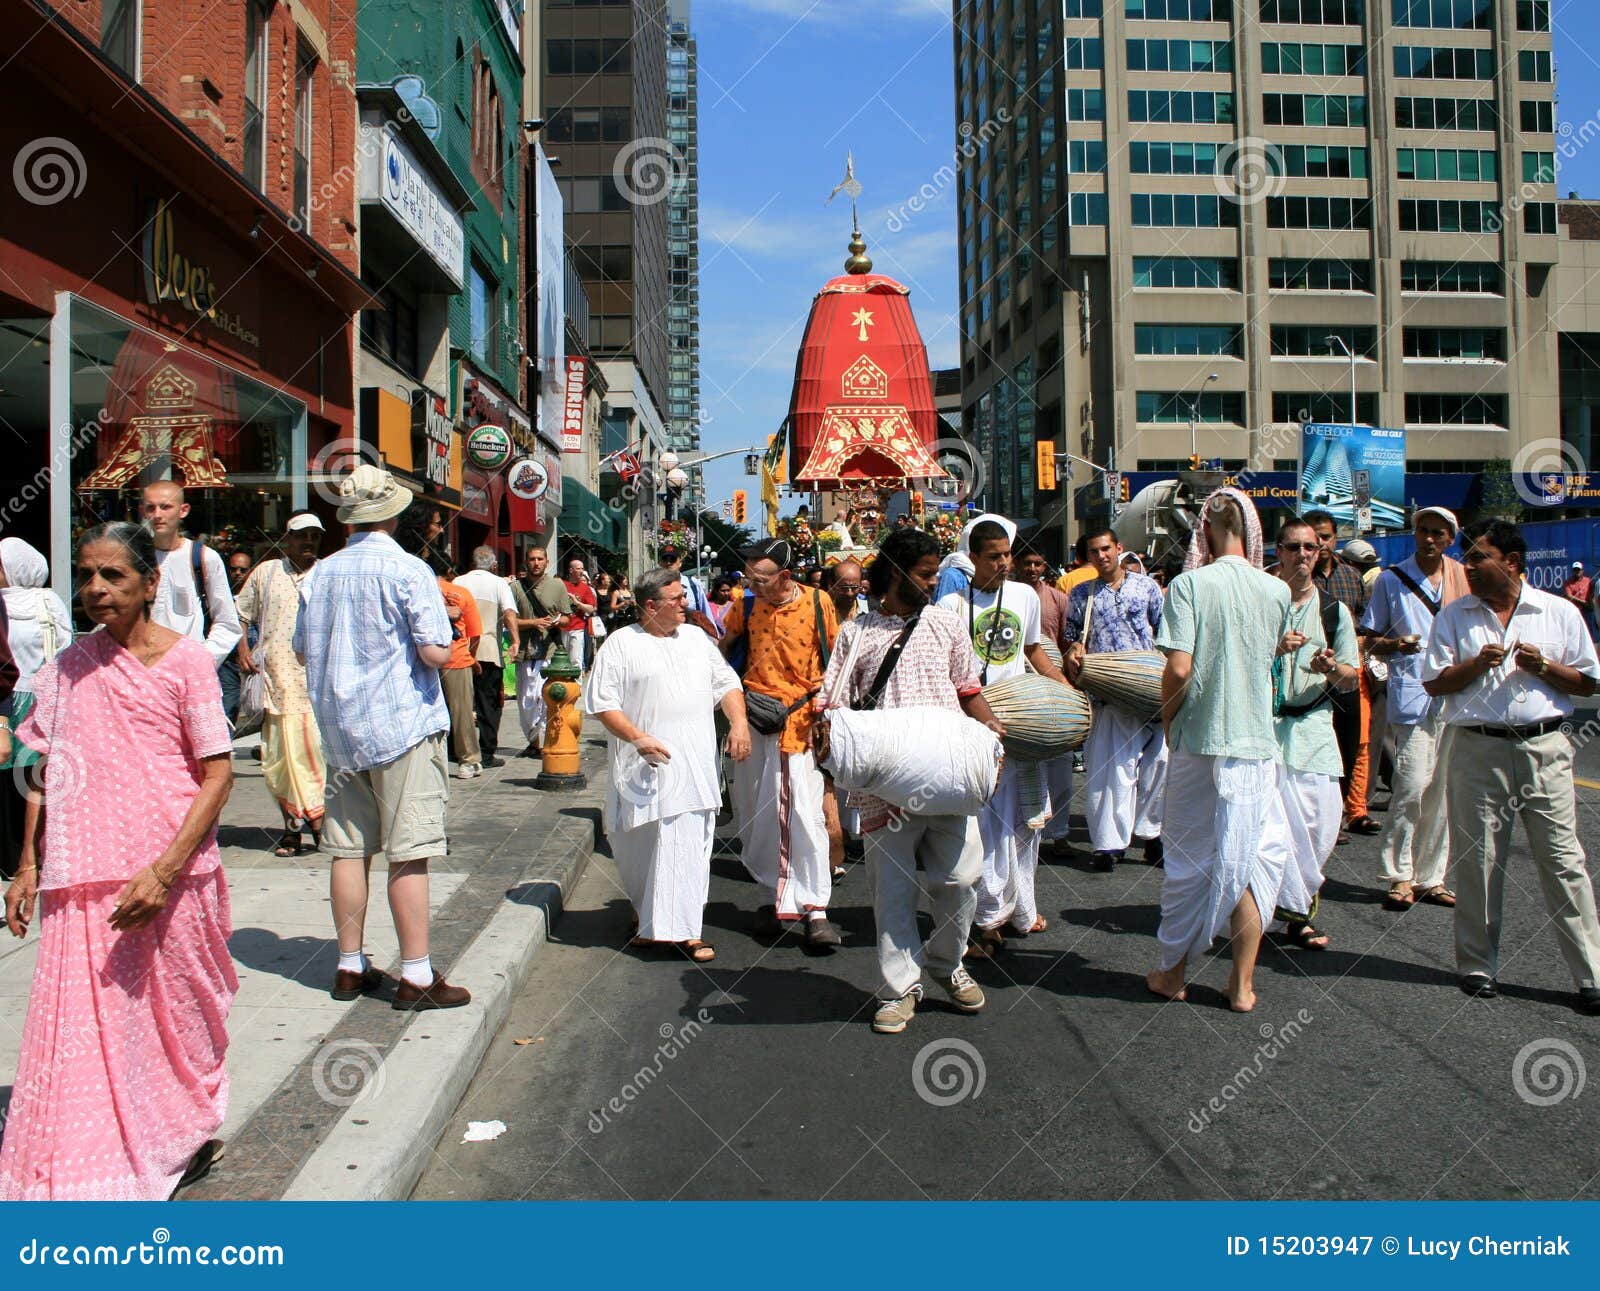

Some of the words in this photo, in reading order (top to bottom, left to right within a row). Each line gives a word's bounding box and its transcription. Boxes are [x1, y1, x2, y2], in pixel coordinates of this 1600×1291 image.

[425, 391, 454, 448] Money
[566, 360, 584, 430] SUNRISE
[426, 437, 451, 487] Mart
[470, 442, 506, 452] Heineken
[1566, 475, 1591, 486] RBC
